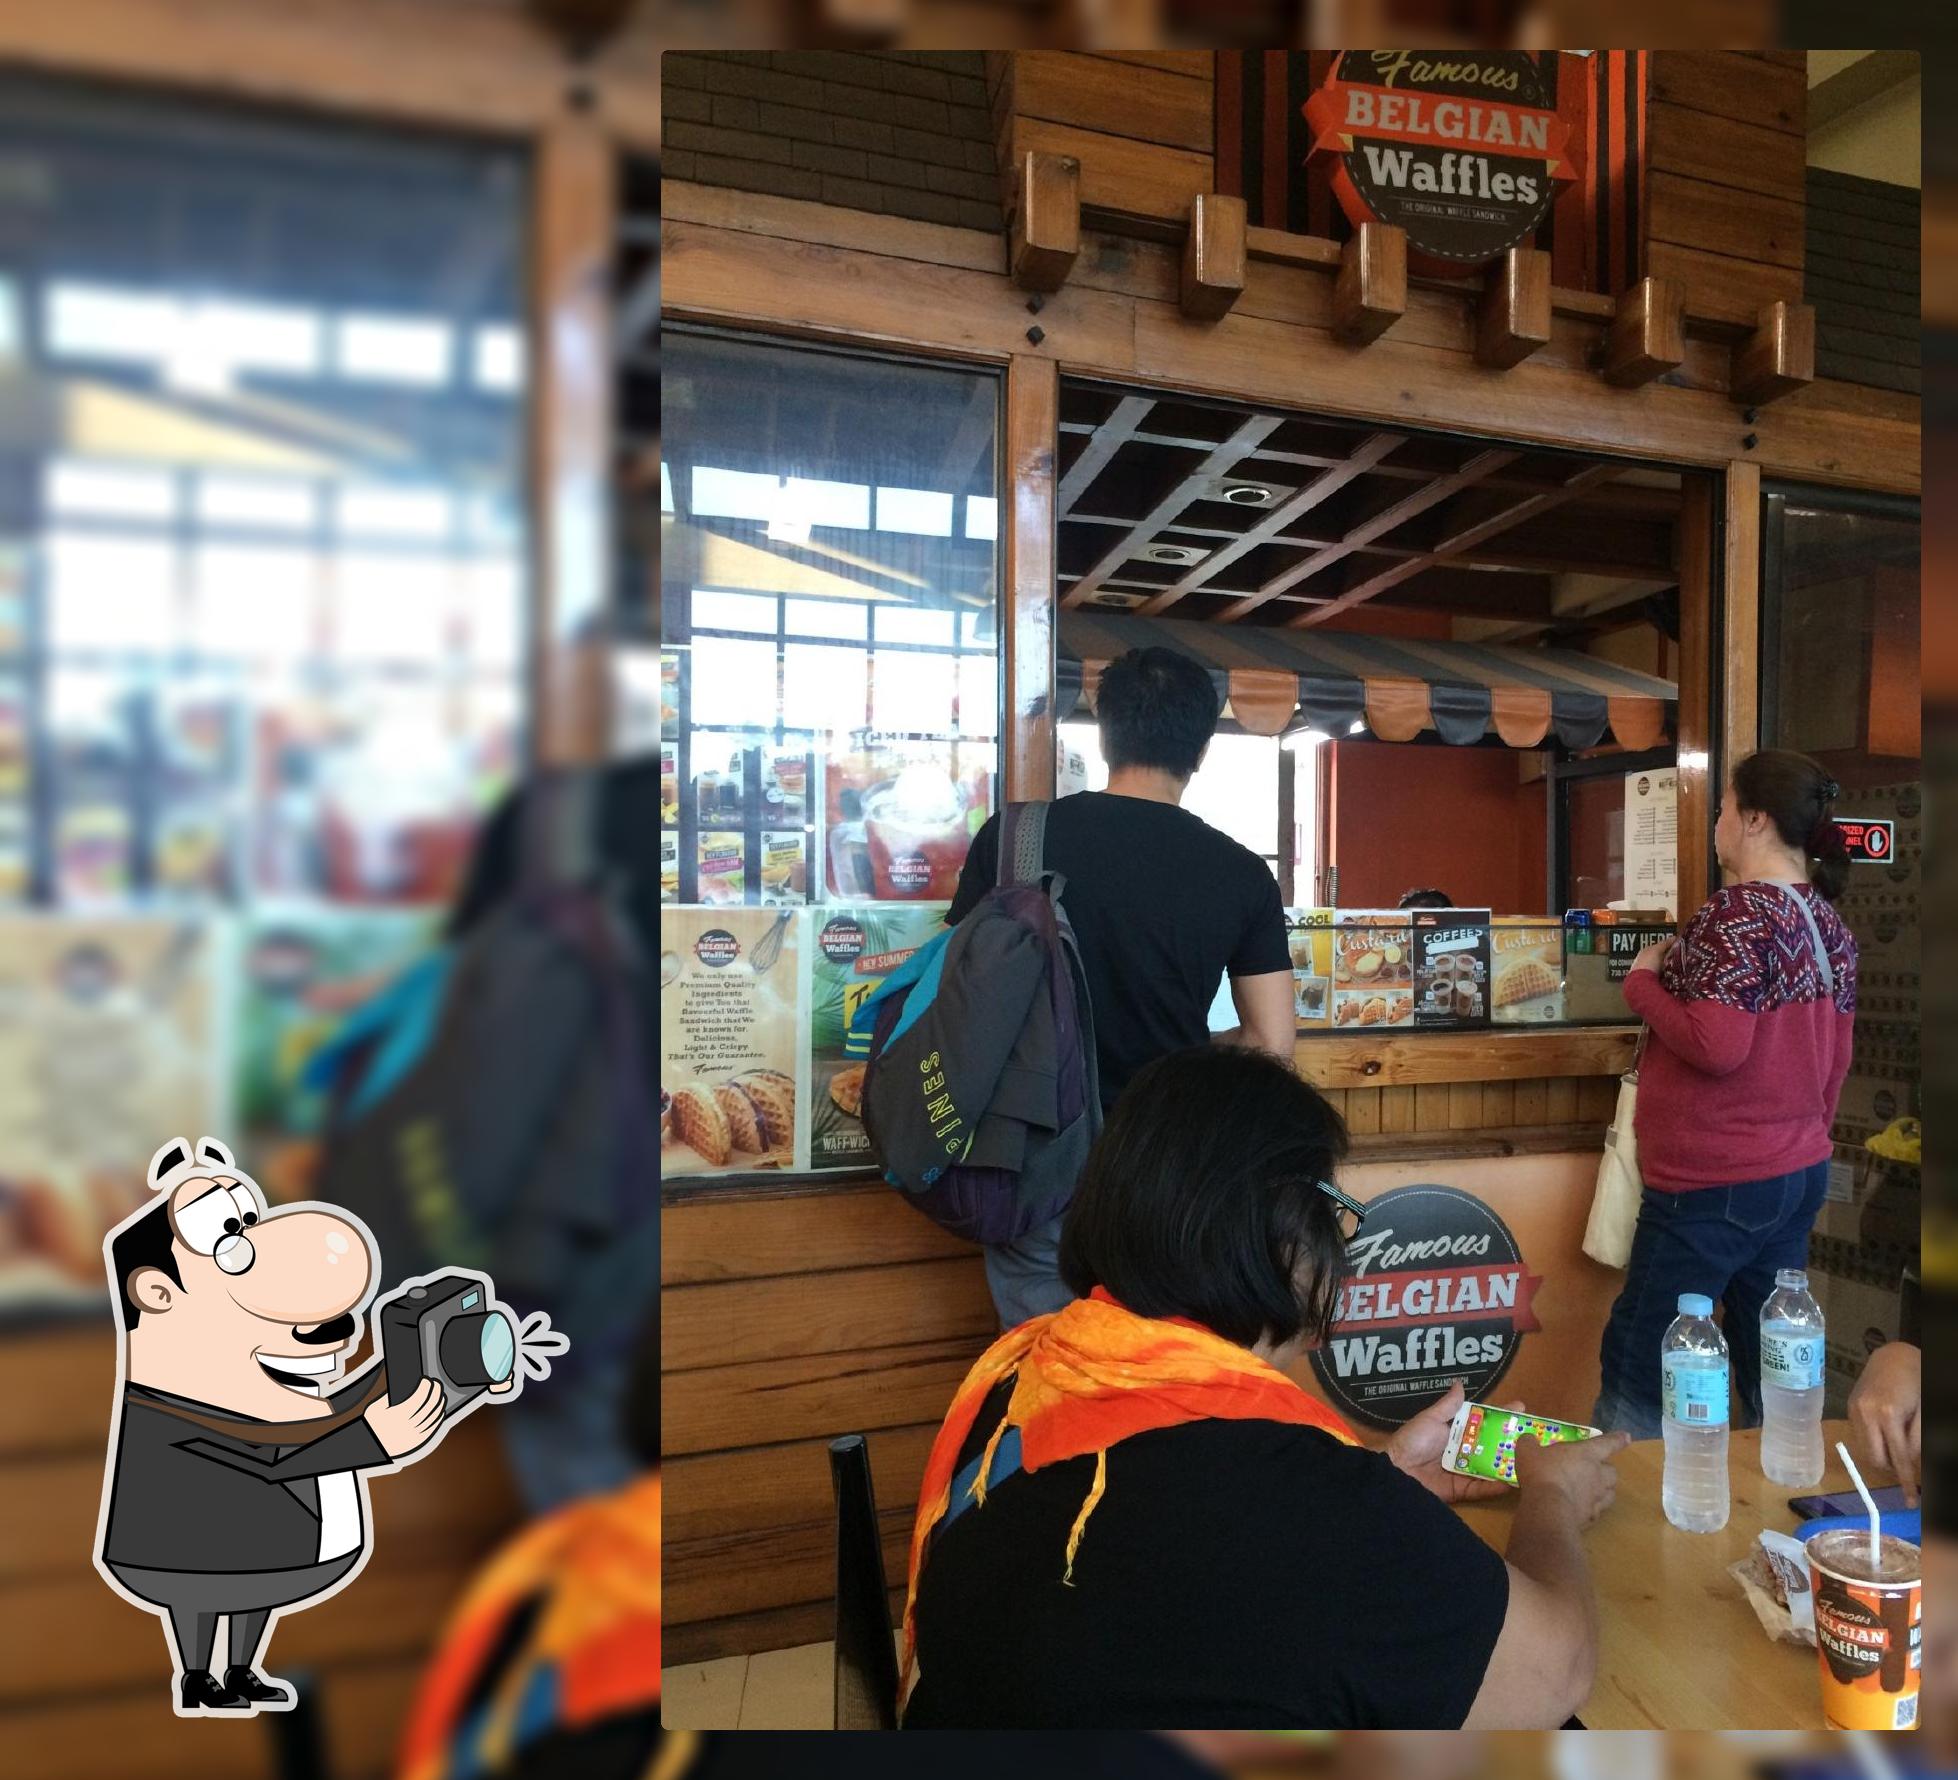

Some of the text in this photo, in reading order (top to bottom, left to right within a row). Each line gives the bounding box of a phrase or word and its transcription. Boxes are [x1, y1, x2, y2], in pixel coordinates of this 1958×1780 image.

[1371, 50, 1519, 91] Famous
[1345, 90, 1549, 150] BELGIAN
[1362, 145, 1539, 205] Waffles
[698, 943, 737, 951] BELGIAN
[823, 934, 862, 943] BELGIAN
[1612, 933, 1636, 951] PAY
[700, 951, 735, 959] Waffles
[825, 944, 860, 953] Waffles
[723, 981, 756, 989] Quality
[691, 990, 743, 998] Ingredients
[680, 1017, 722, 1025] Sandwich
[1347, 1229, 1491, 1279] Famous
[1330, 1326, 1504, 1378] Waffles
[1364, 1386, 1377, 1396] THE
[1378, 1383, 1408, 1395] ORIGINAL
[1409, 1379, 1434, 1391] WAFFLE
[1819, 1598, 1871, 1625] Famous
[1820, 1627, 1880, 1662] Waffles
